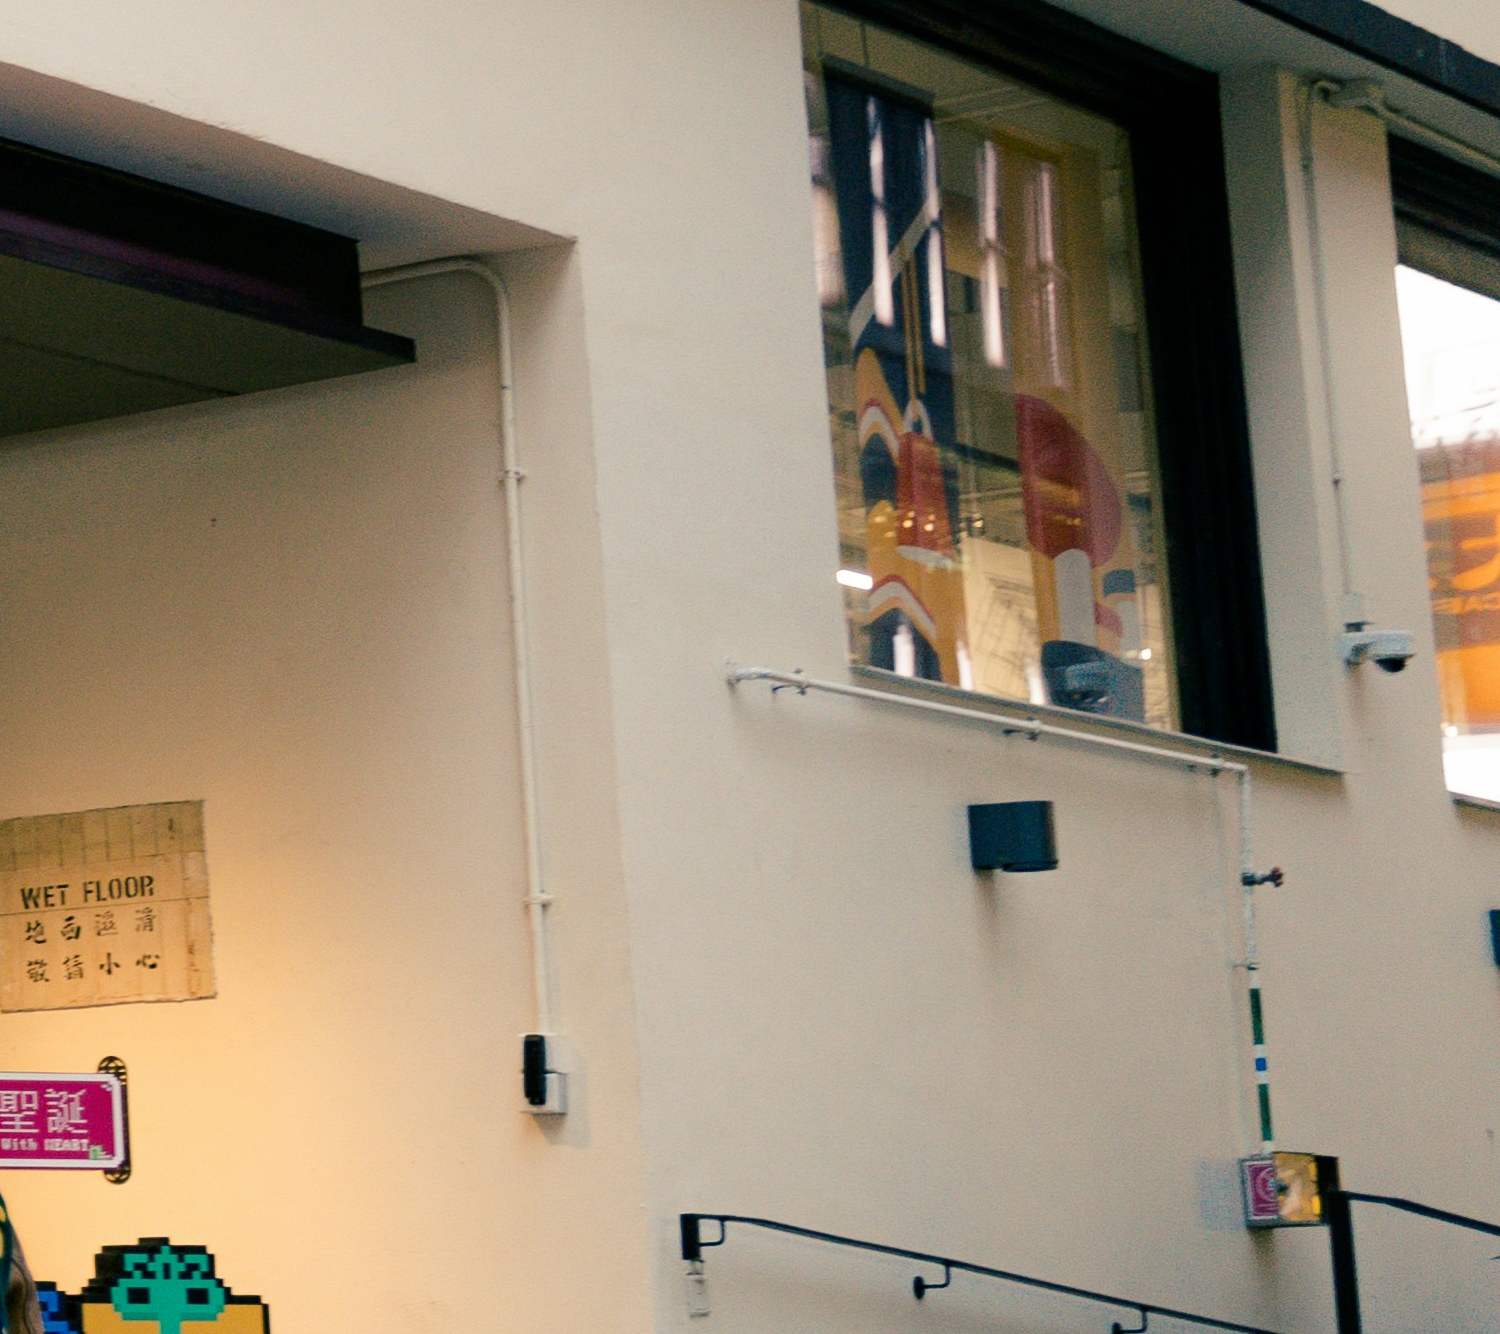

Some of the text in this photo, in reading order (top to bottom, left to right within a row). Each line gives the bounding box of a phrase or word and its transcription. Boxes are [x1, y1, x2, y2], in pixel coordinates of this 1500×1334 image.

[20, 875, 155, 910] WET FLOOR
[0, 1137, 39, 1151] With
[44, 1138, 90, 1152] HEART
